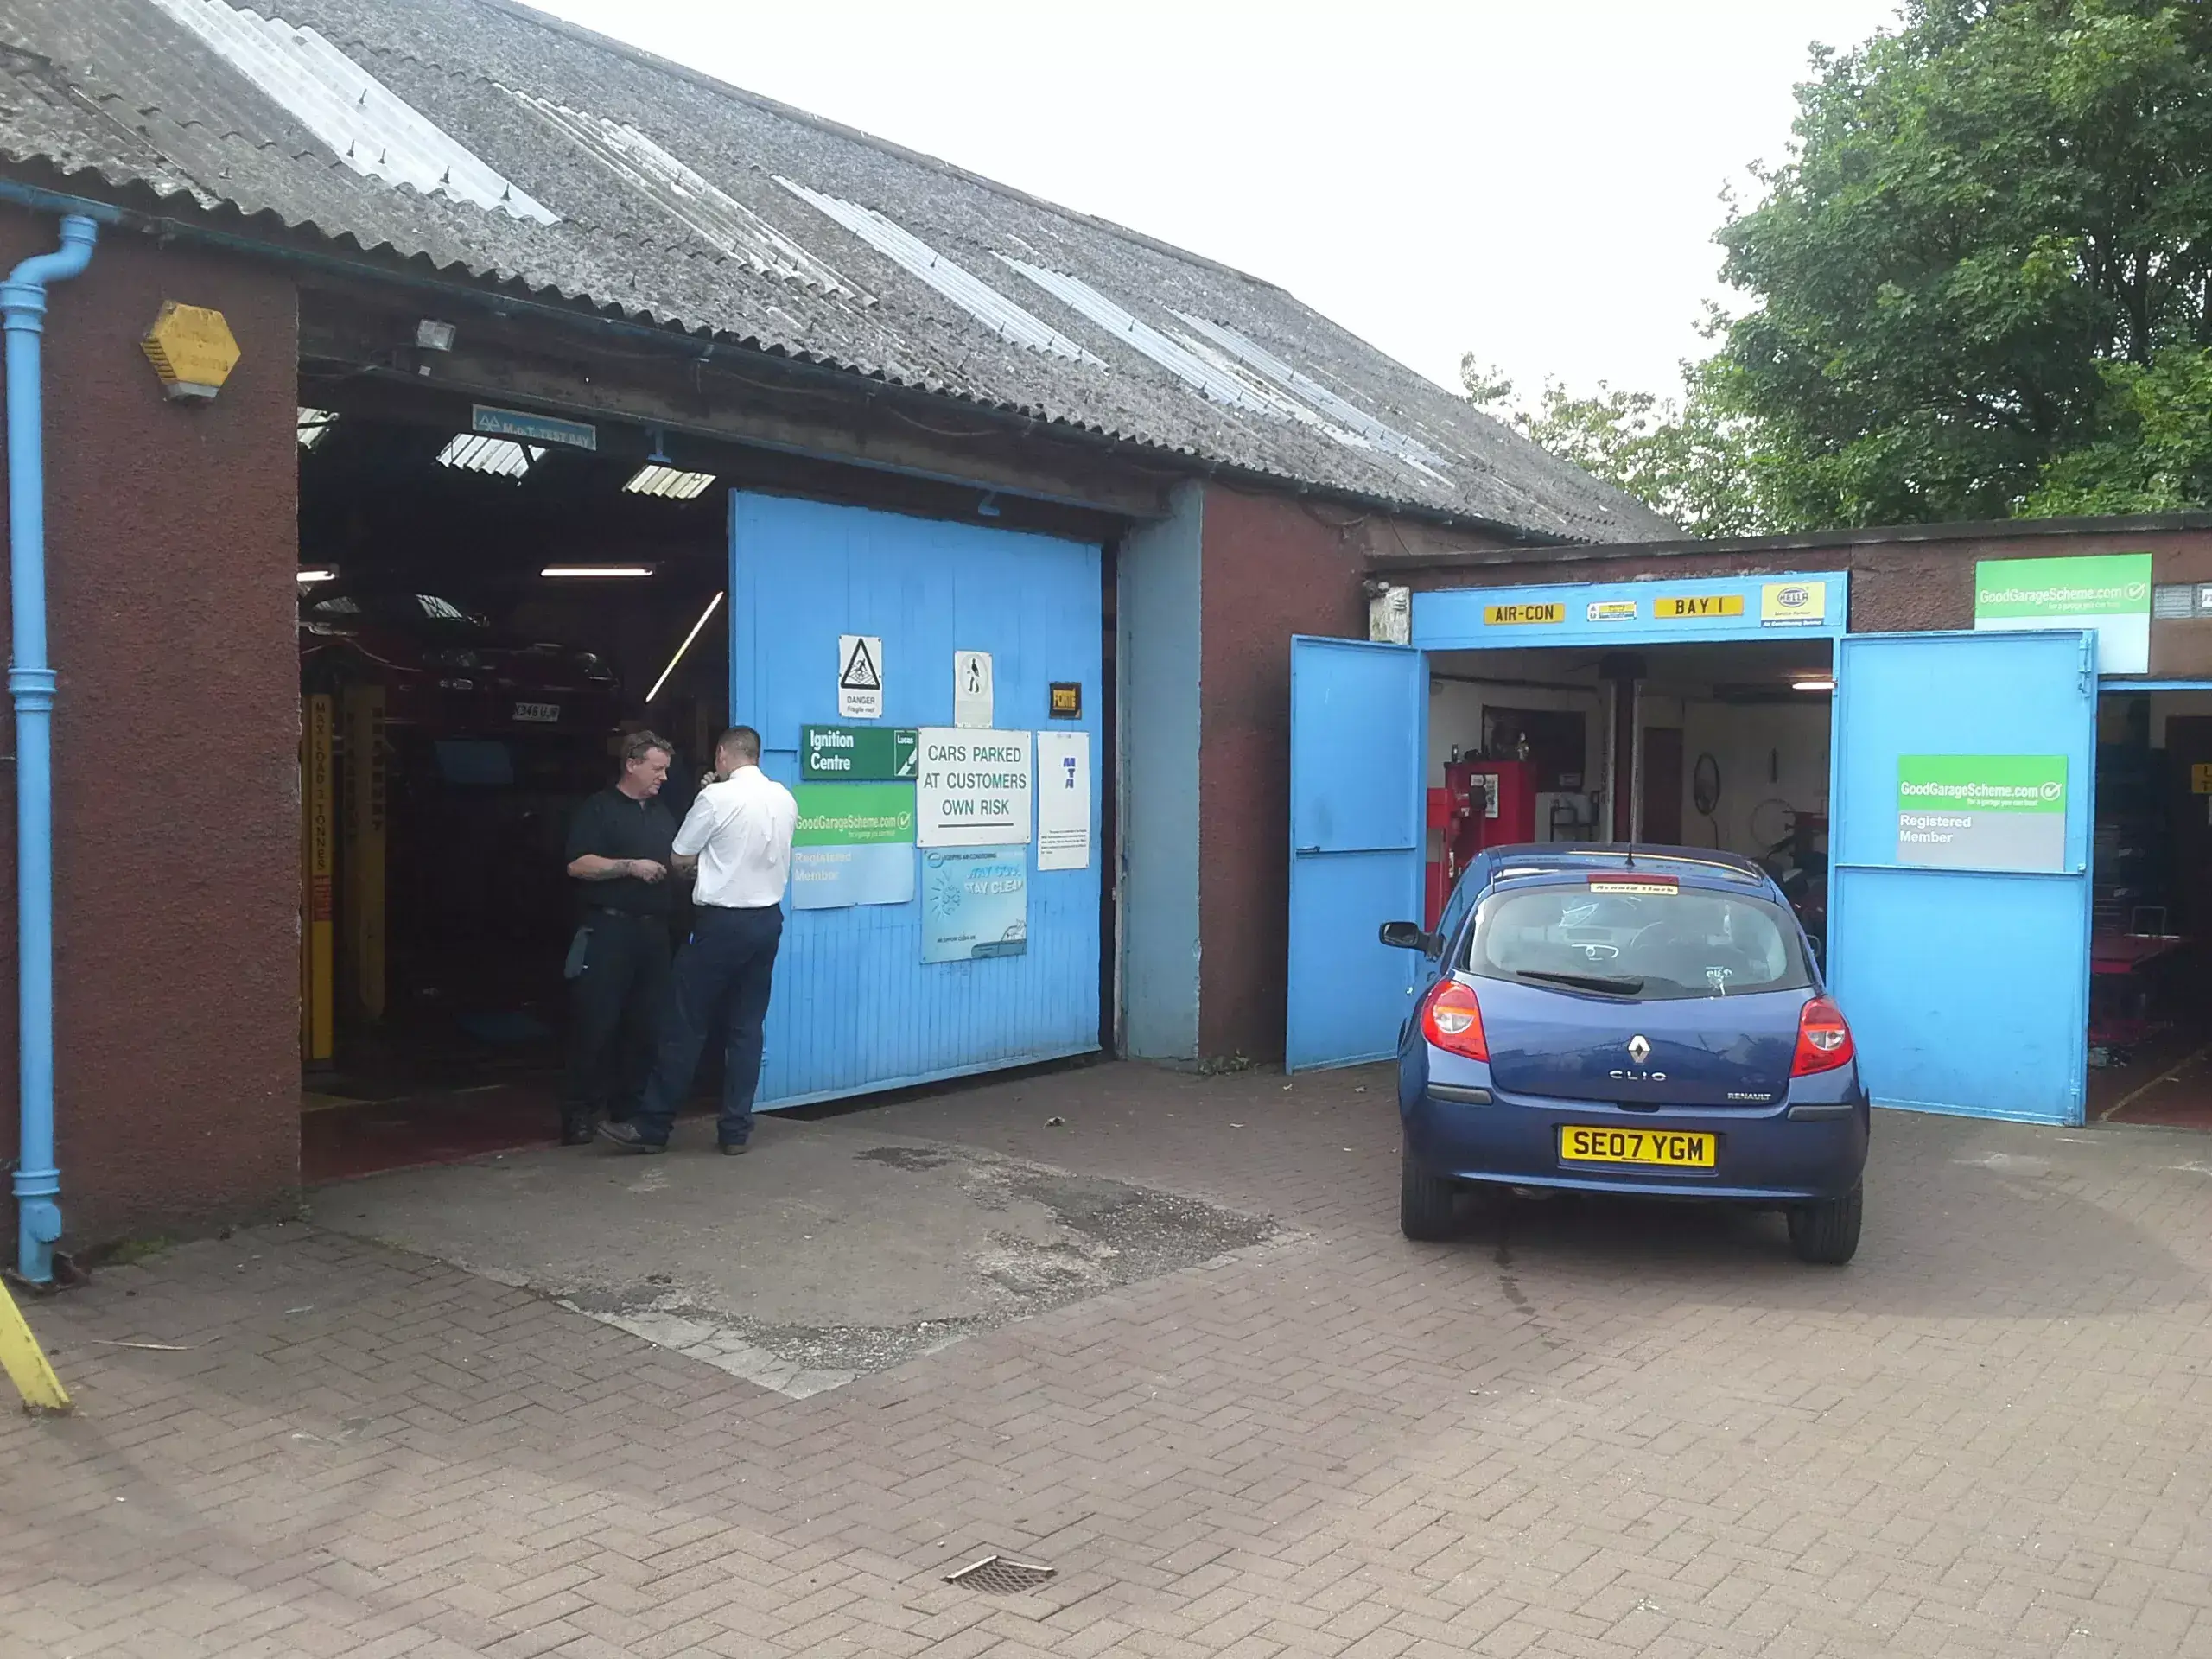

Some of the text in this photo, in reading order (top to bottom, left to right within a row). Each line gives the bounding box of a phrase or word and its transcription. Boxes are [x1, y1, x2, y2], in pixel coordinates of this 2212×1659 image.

[1780, 592, 1809, 601] HELLA
[1980, 586, 2122, 605] GoodGarageScheme.com
[1495, 604, 1554, 622] AIR-CON
[1675, 596, 1709, 615] BAY
[846, 696, 875, 704] DANGER
[810, 729, 914, 751] Ignition Lucas
[810, 752, 851, 771] Centre
[927, 744, 1022, 763] CARS PARKED
[923, 772, 1027, 790] AT CUSTOMERS
[1900, 781, 2039, 799] GoodGarageScheme.com
[942, 798, 1010, 816] OWN RISK
[795, 814, 896, 833] GoodGarageScheme.com
[1900, 814, 1972, 829] Registered
[1900, 830, 1953, 843] Member
[795, 868, 839, 882] Member
[1609, 1070, 1667, 1082] CLIO
[1727, 1091, 1772, 1101] RENAULT
[1573, 1130, 1704, 1161] SE07 YGM
